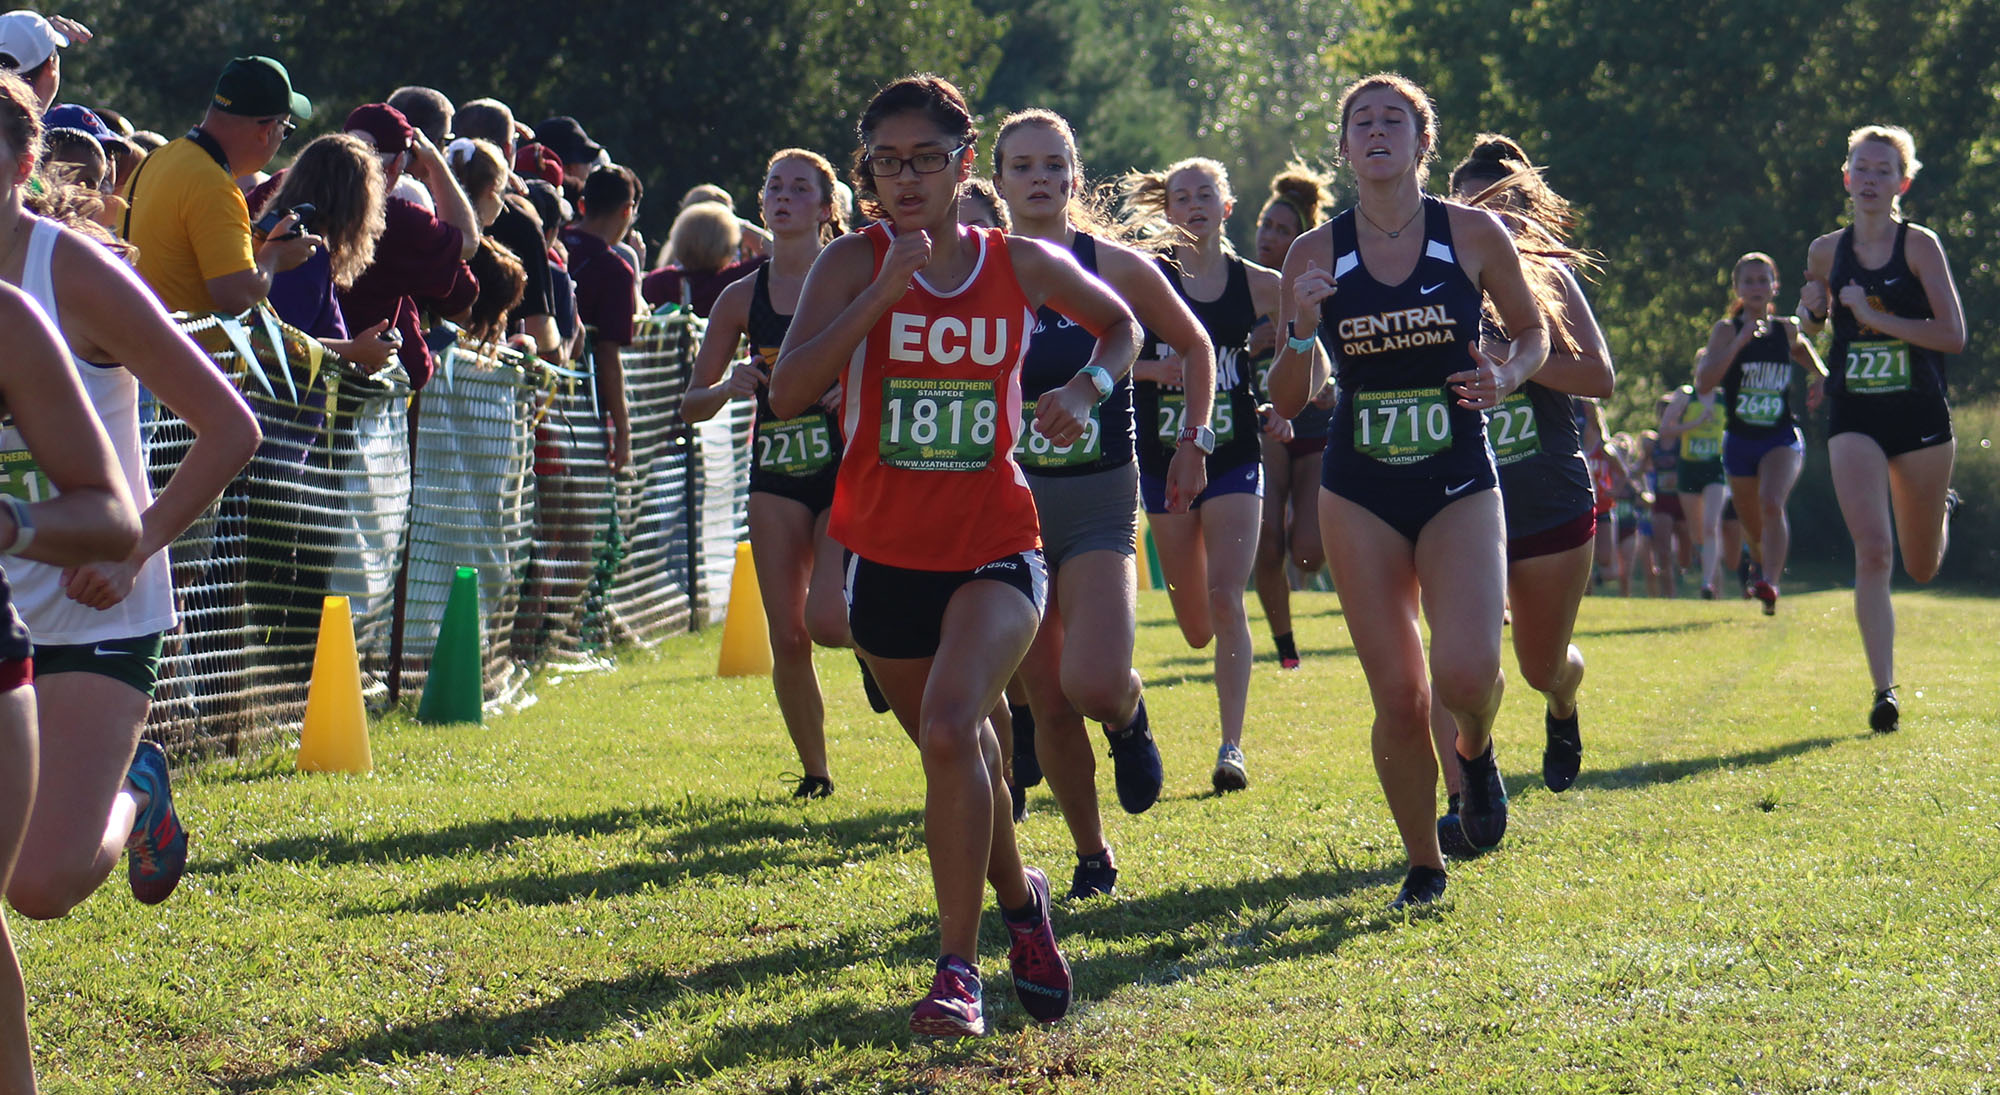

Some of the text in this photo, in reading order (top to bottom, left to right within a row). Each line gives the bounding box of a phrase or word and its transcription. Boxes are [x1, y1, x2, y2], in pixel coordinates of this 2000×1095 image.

[1338, 305, 1457, 340] CENTRAL
[889, 311, 1007, 366] ECU
[1344, 330, 1455, 356] OKLAHOMA
[1741, 361, 1791, 391] TRUMAN
[1846, 350, 1906, 378] 2221
[890, 380, 992, 390] MISSOURI SOUTHERN
[1359, 388, 1441, 400] MISSOURI SOUTHERN
[1158, 403, 1233, 437] 25
[1735, 394, 1784, 416] 2649
[888, 398, 996, 445] 1818
[1013, 417, 1099, 454] 289
[1359, 403, 1449, 445] 1710
[1493, 406, 1536, 446] 22
[0, 451, 32, 462] THERN
[758, 427, 829, 466] 2215
[895, 460, 988, 469] WWW.VSATHLETICS.COM
[1015, 978, 1064, 999] BROOKS
